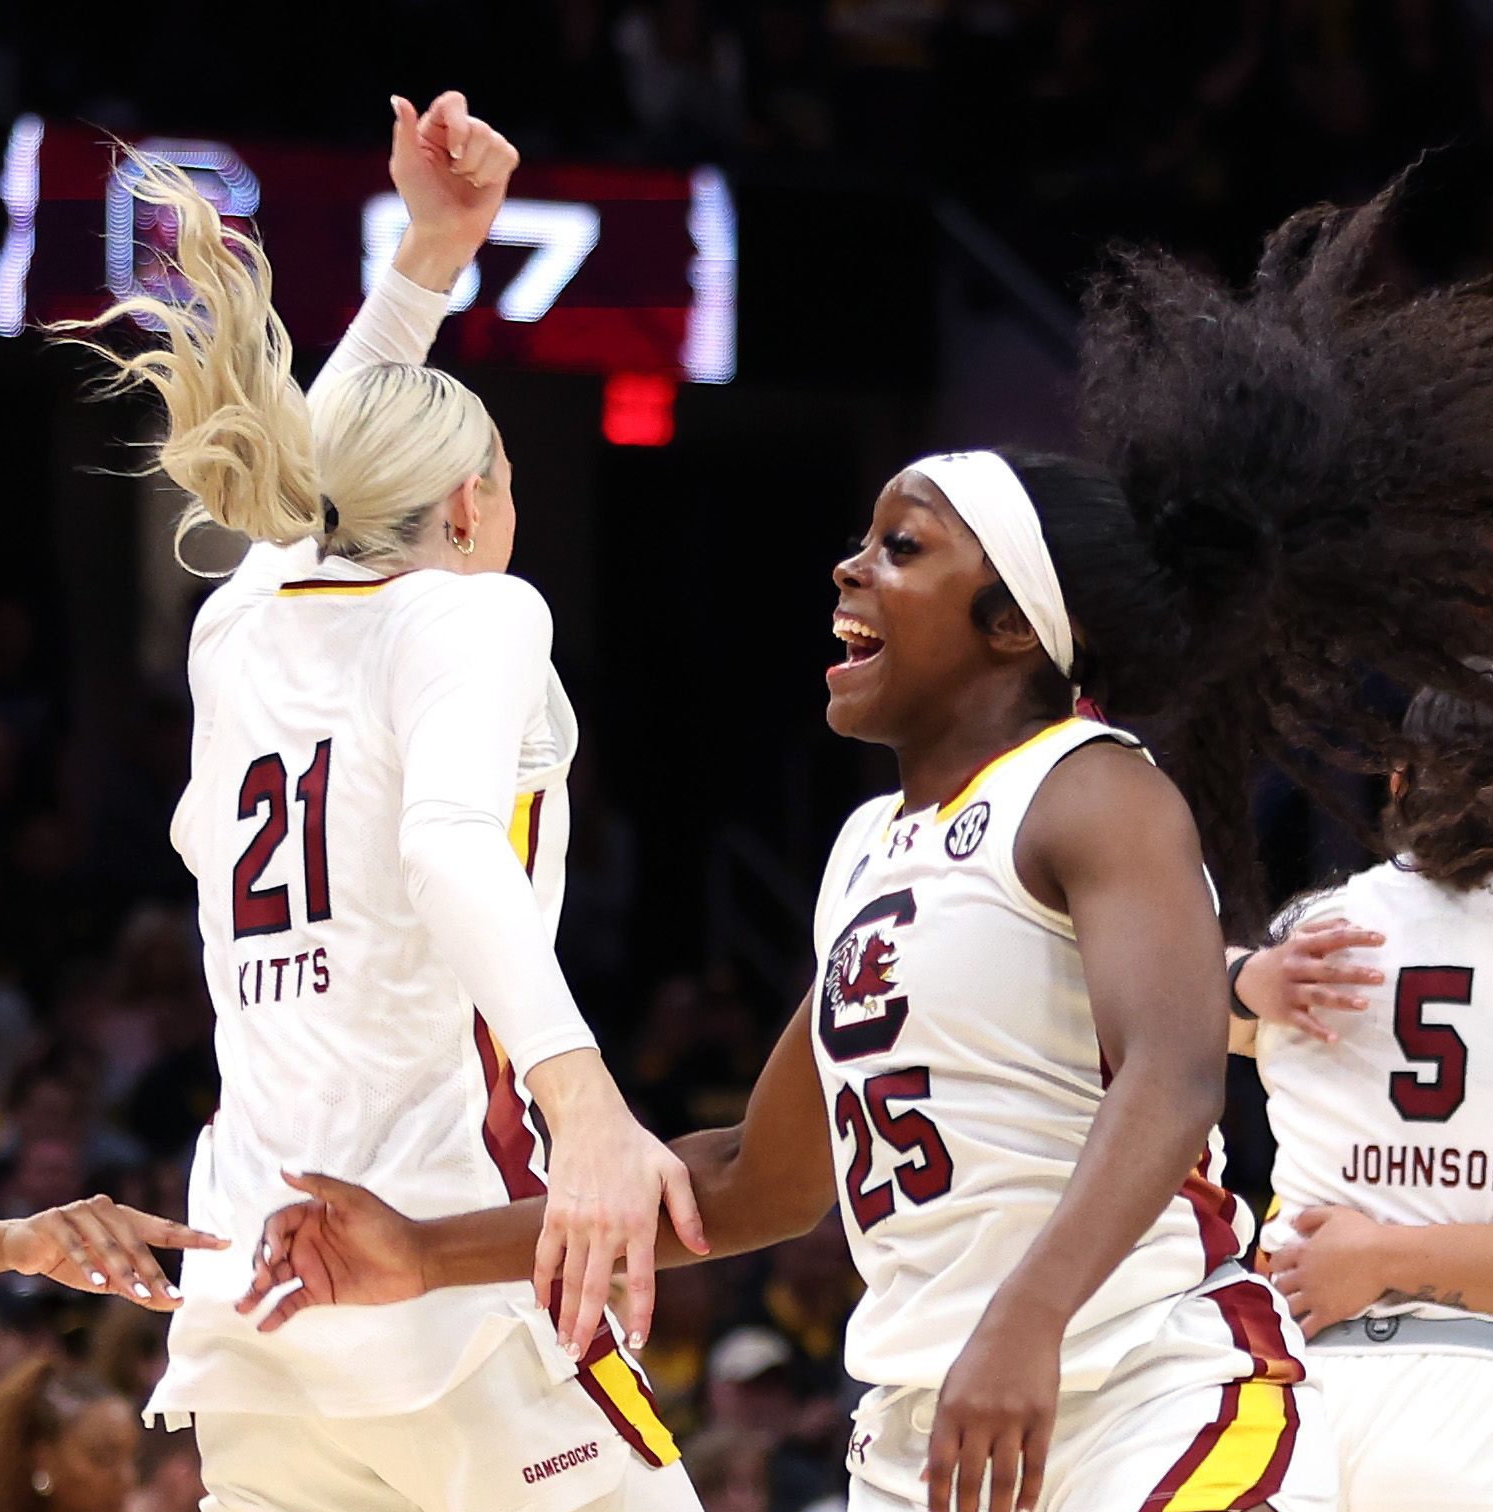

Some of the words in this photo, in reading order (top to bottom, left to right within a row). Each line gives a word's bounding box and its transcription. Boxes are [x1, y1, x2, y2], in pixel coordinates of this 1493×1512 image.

[233, 737, 333, 942] 21
[238, 947, 330, 1010] KITTS
[1389, 966, 1475, 1123] 5
[834, 1066, 953, 1235] 25
[523, 1442, 599, 1484] GAMECOCKS
